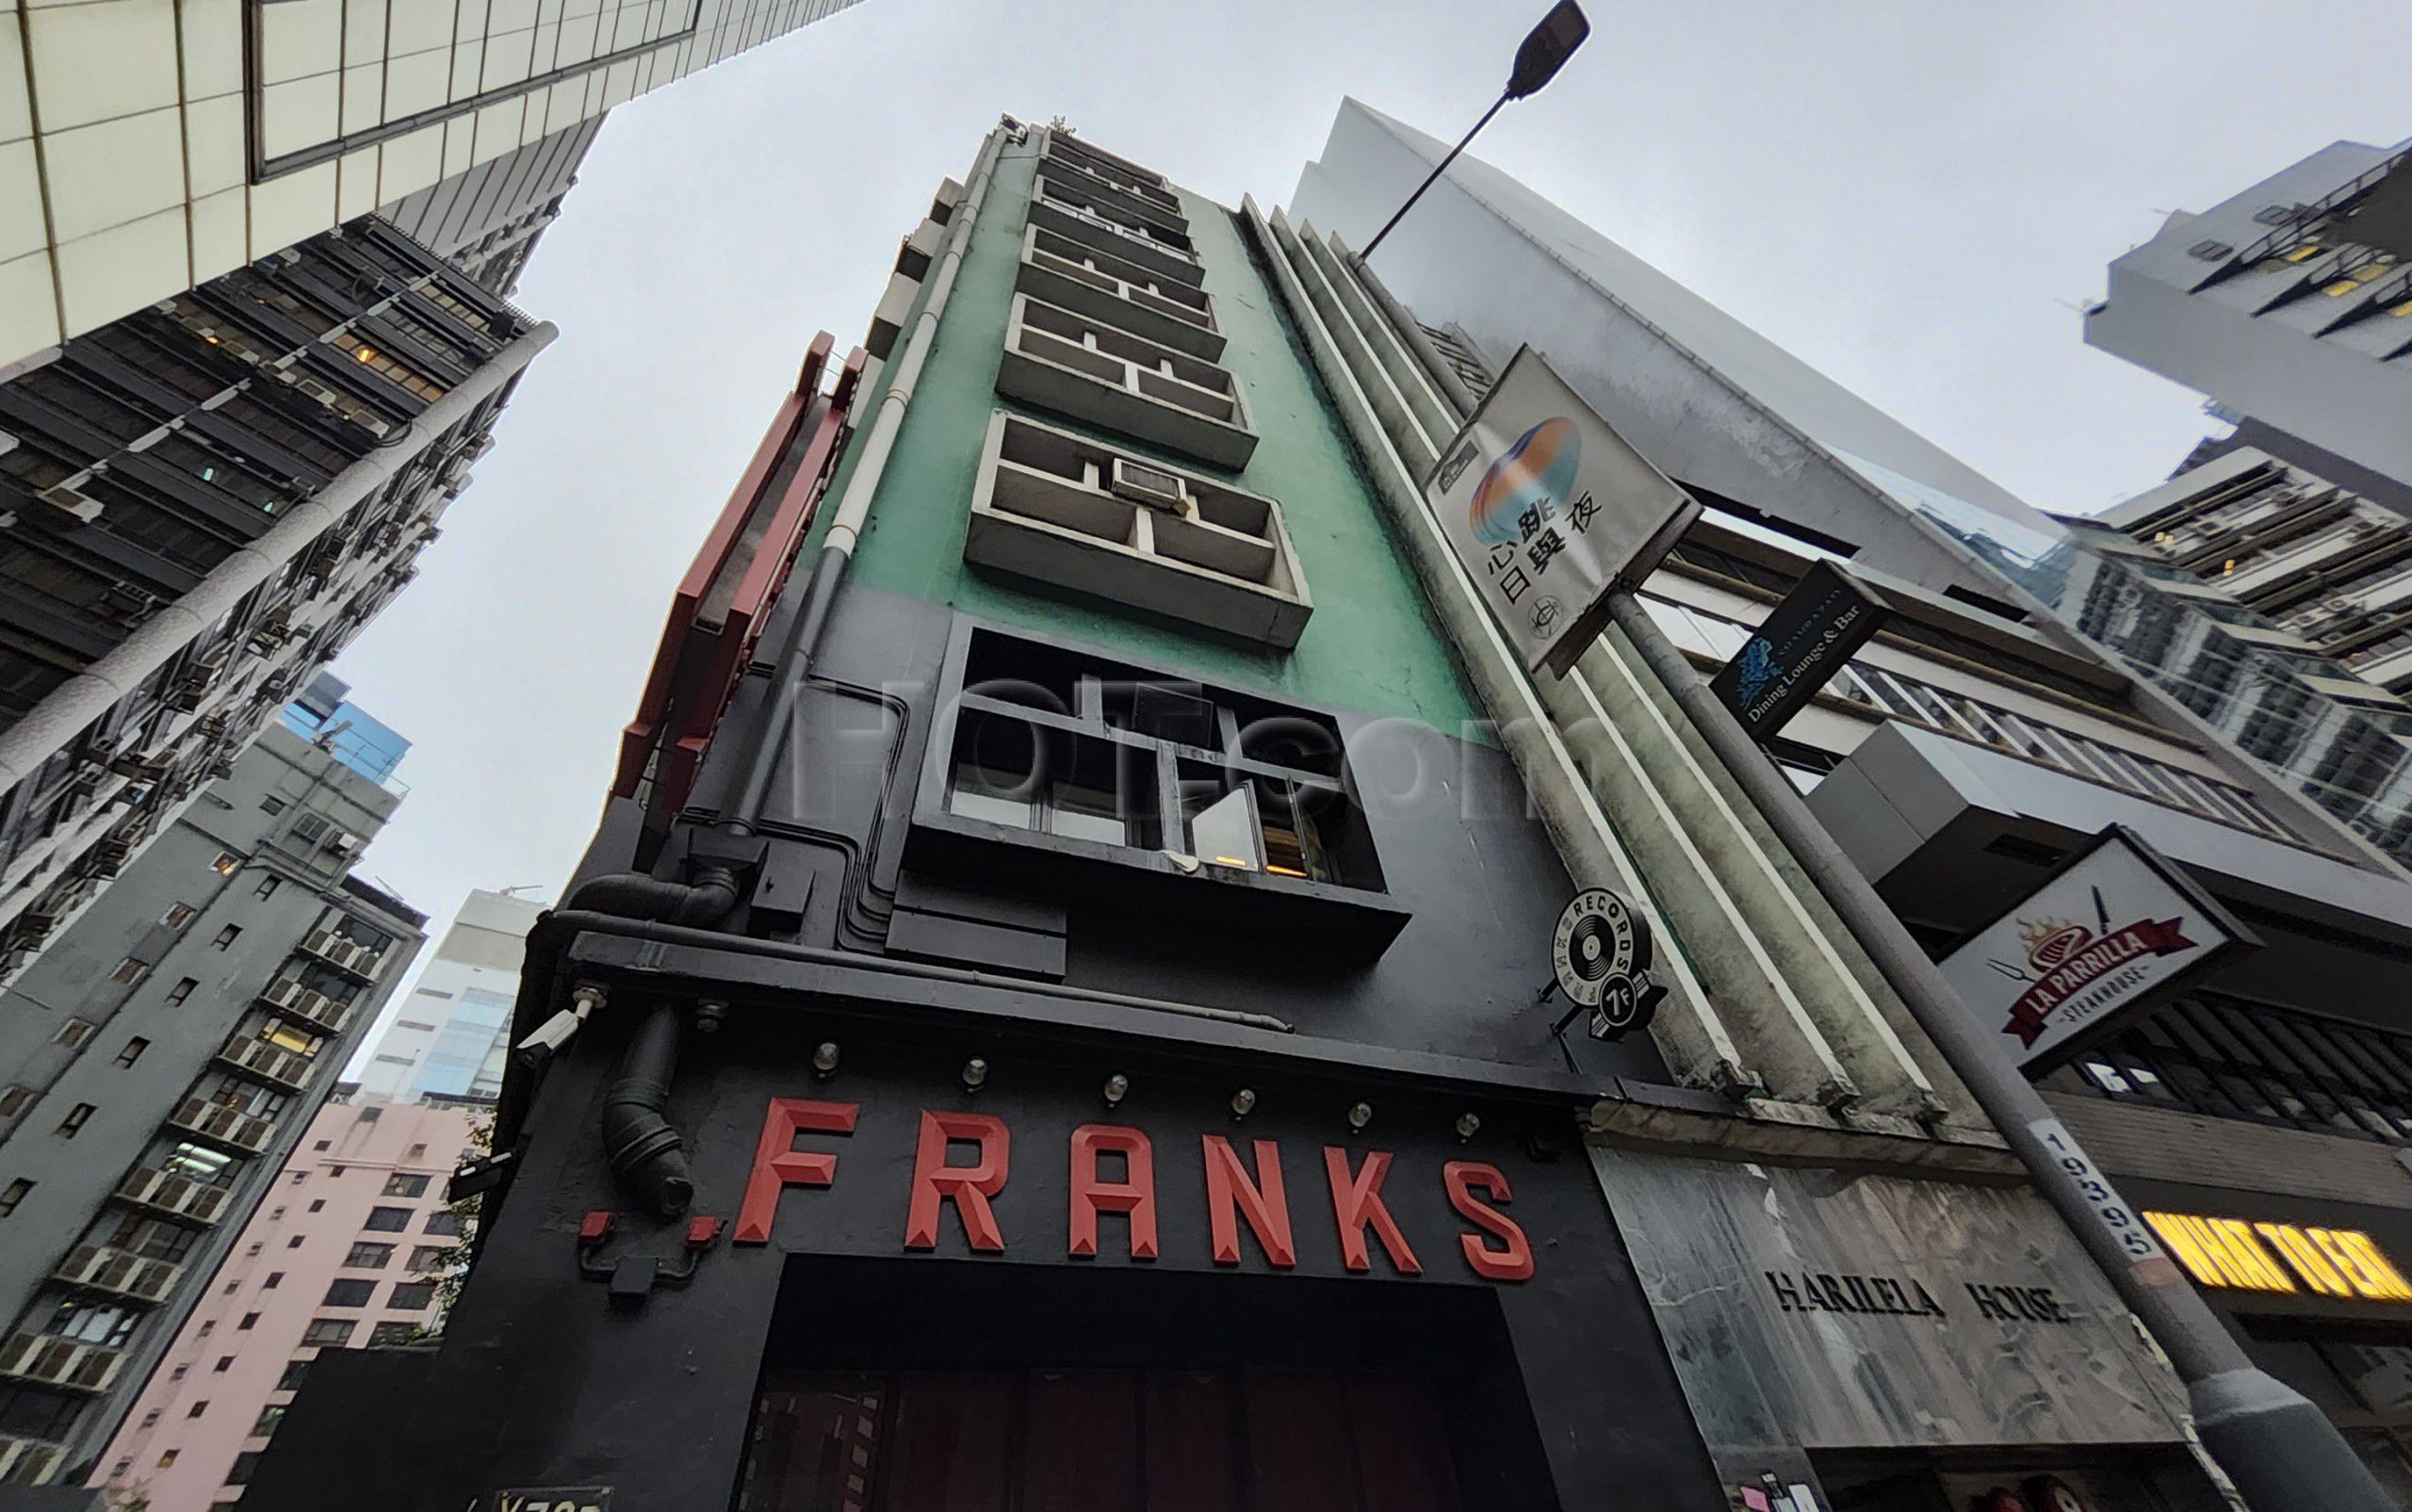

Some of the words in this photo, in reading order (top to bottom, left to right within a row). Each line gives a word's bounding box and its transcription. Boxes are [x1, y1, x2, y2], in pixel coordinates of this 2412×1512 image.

[1487, 496, 1557, 576] 心跳
[1499, 490, 1603, 606] 日與夜
[1748, 684, 1787, 723] Dining
[1786, 642, 1826, 686] Lounge
[1823, 629, 1838, 644] &
[1833, 604, 1861, 630] Bar
[1573, 896, 1631, 971] RECORDS
[2025, 985, 2060, 1016] LA
[2053, 932, 2148, 995] PARRILLA
[1605, 989, 1631, 1016] 7F
[732, 1097, 1536, 1282] FRANKS
[2047, 1133, 2152, 1256] 19395
[1765, 1271, 1947, 1319] HARILELA
[1964, 1282, 2071, 1324] HOUSE
[2142, 1211, 2297, 1293] WHAT
[2254, 1222, 2353, 1297] TO
[2306, 1227, 2412, 1303] EAT
